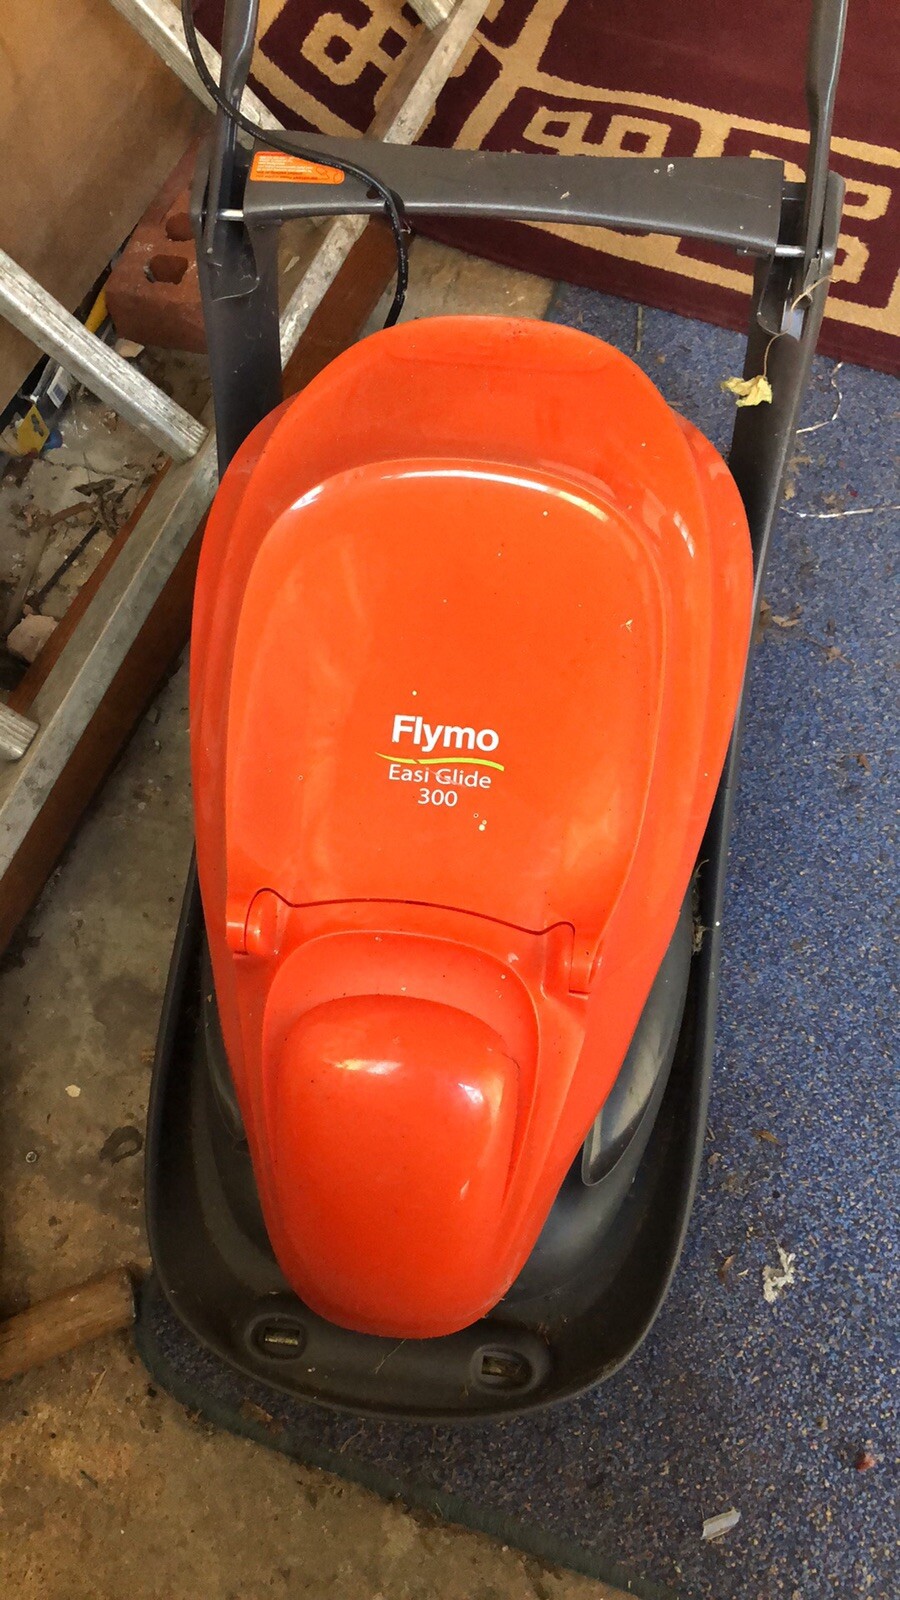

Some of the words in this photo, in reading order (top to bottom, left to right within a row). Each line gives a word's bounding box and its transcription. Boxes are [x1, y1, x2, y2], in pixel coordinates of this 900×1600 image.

[392, 714, 499, 752] Flymo
[389, 764, 429, 783] Easi
[435, 768, 491, 789] Glide
[417, 788, 458, 807] 300
